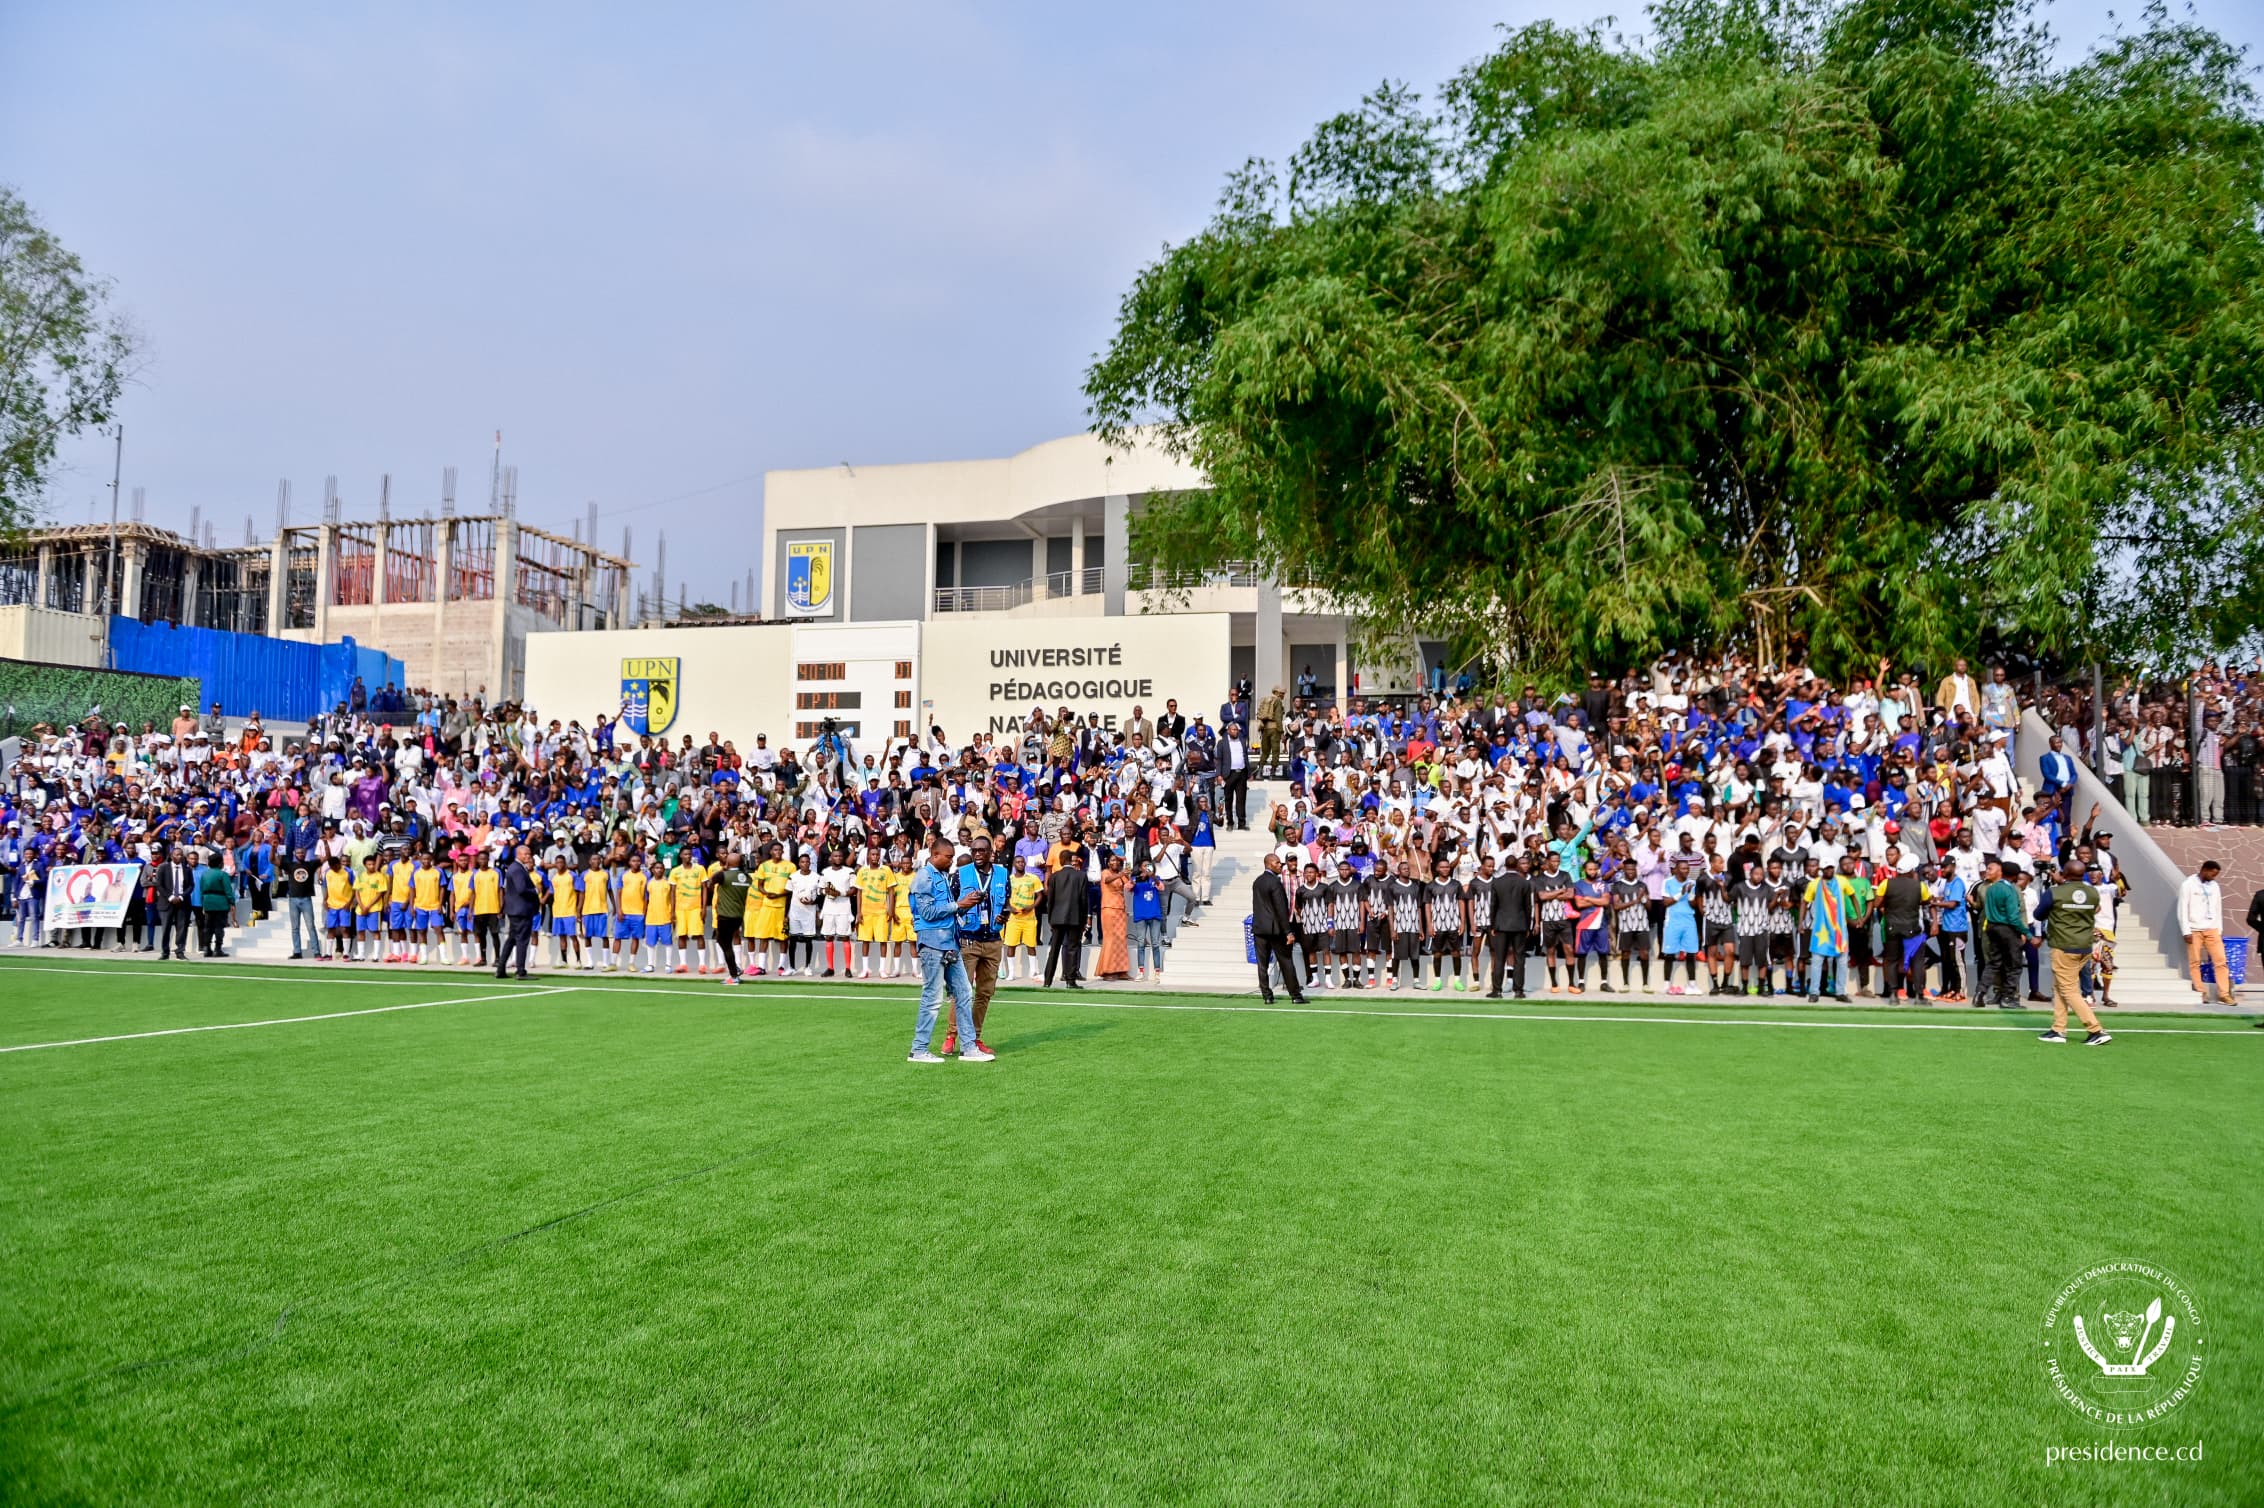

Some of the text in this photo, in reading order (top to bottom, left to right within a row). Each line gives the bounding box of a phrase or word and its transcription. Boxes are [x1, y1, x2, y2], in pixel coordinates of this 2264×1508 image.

[990, 643, 1122, 668] UNIVERSITÉ
[627, 660, 673, 678] UPN
[990, 678, 1152, 700] PÉDAGOGIQUE
